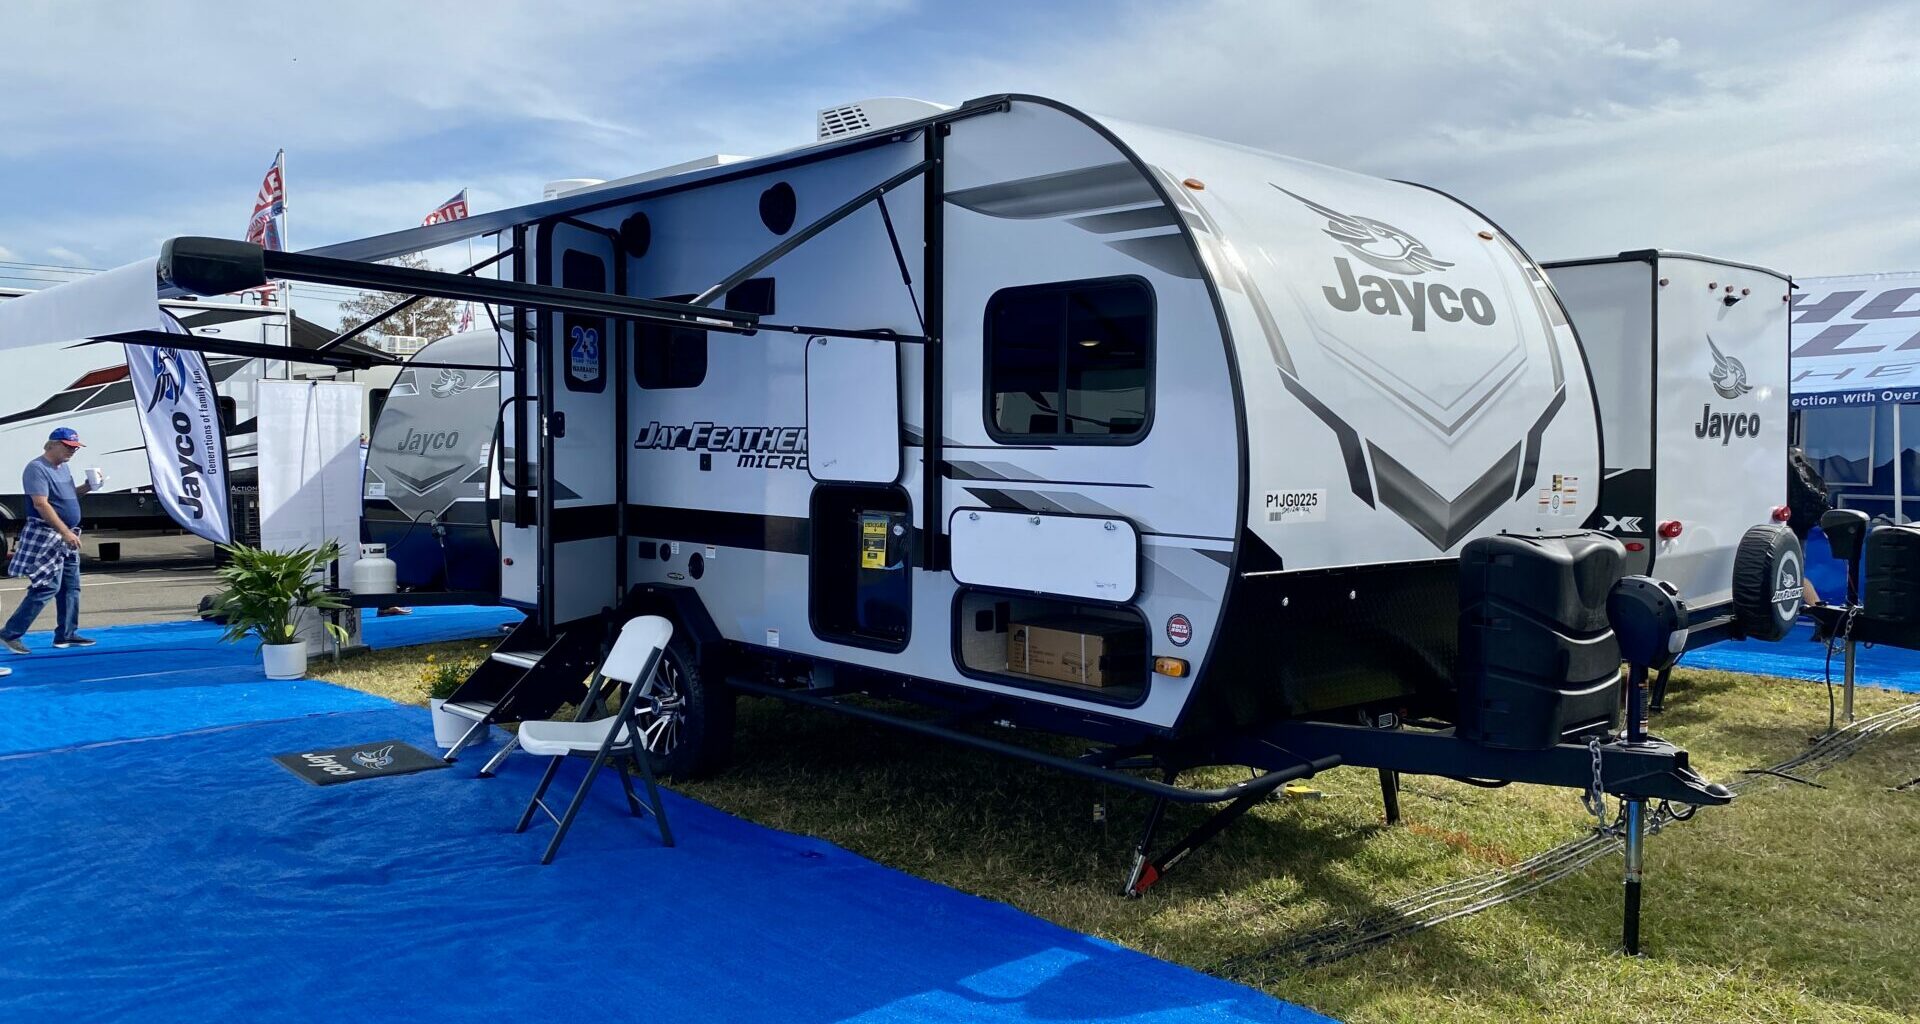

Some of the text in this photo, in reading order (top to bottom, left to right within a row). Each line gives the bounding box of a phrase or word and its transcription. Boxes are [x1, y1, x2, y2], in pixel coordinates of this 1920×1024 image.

[1322, 256, 1496, 332] Jayco
[195, 386, 209, 413] family
[1843, 391, 1876, 403] With
[1881, 389, 1919, 401] Over
[200, 413, 211, 424] of
[1695, 403, 1761, 446] Jayco
[203, 425, 217, 475] Generations
[397, 427, 459, 456] Jayco
[634, 421, 685, 450] JAY
[172, 411, 205, 520] Jayco
[1266, 493, 1318, 508] P1JG0225
[301, 753, 356, 775] Jayco
